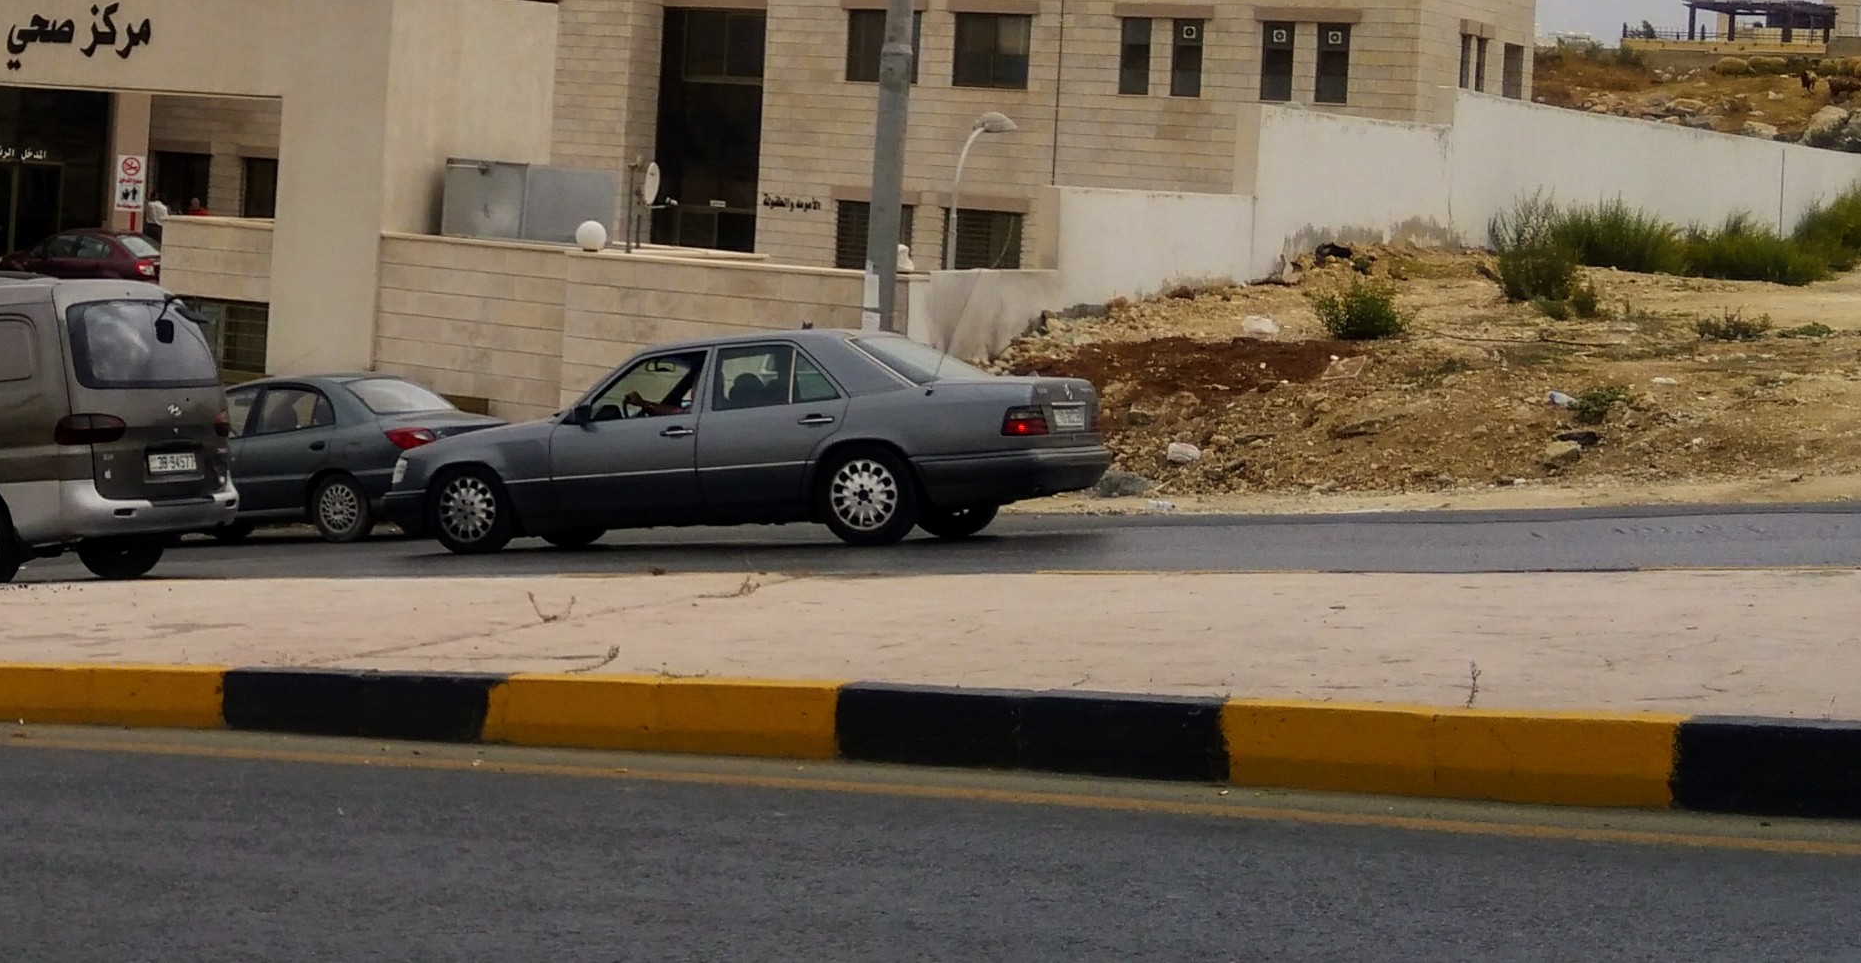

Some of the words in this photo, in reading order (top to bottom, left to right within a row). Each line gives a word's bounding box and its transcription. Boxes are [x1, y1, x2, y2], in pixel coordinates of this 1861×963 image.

[5, 12, 76, 71] صحي
[79, 2, 152, 60] مركز
[21, 148, 47, 160] المدخل
